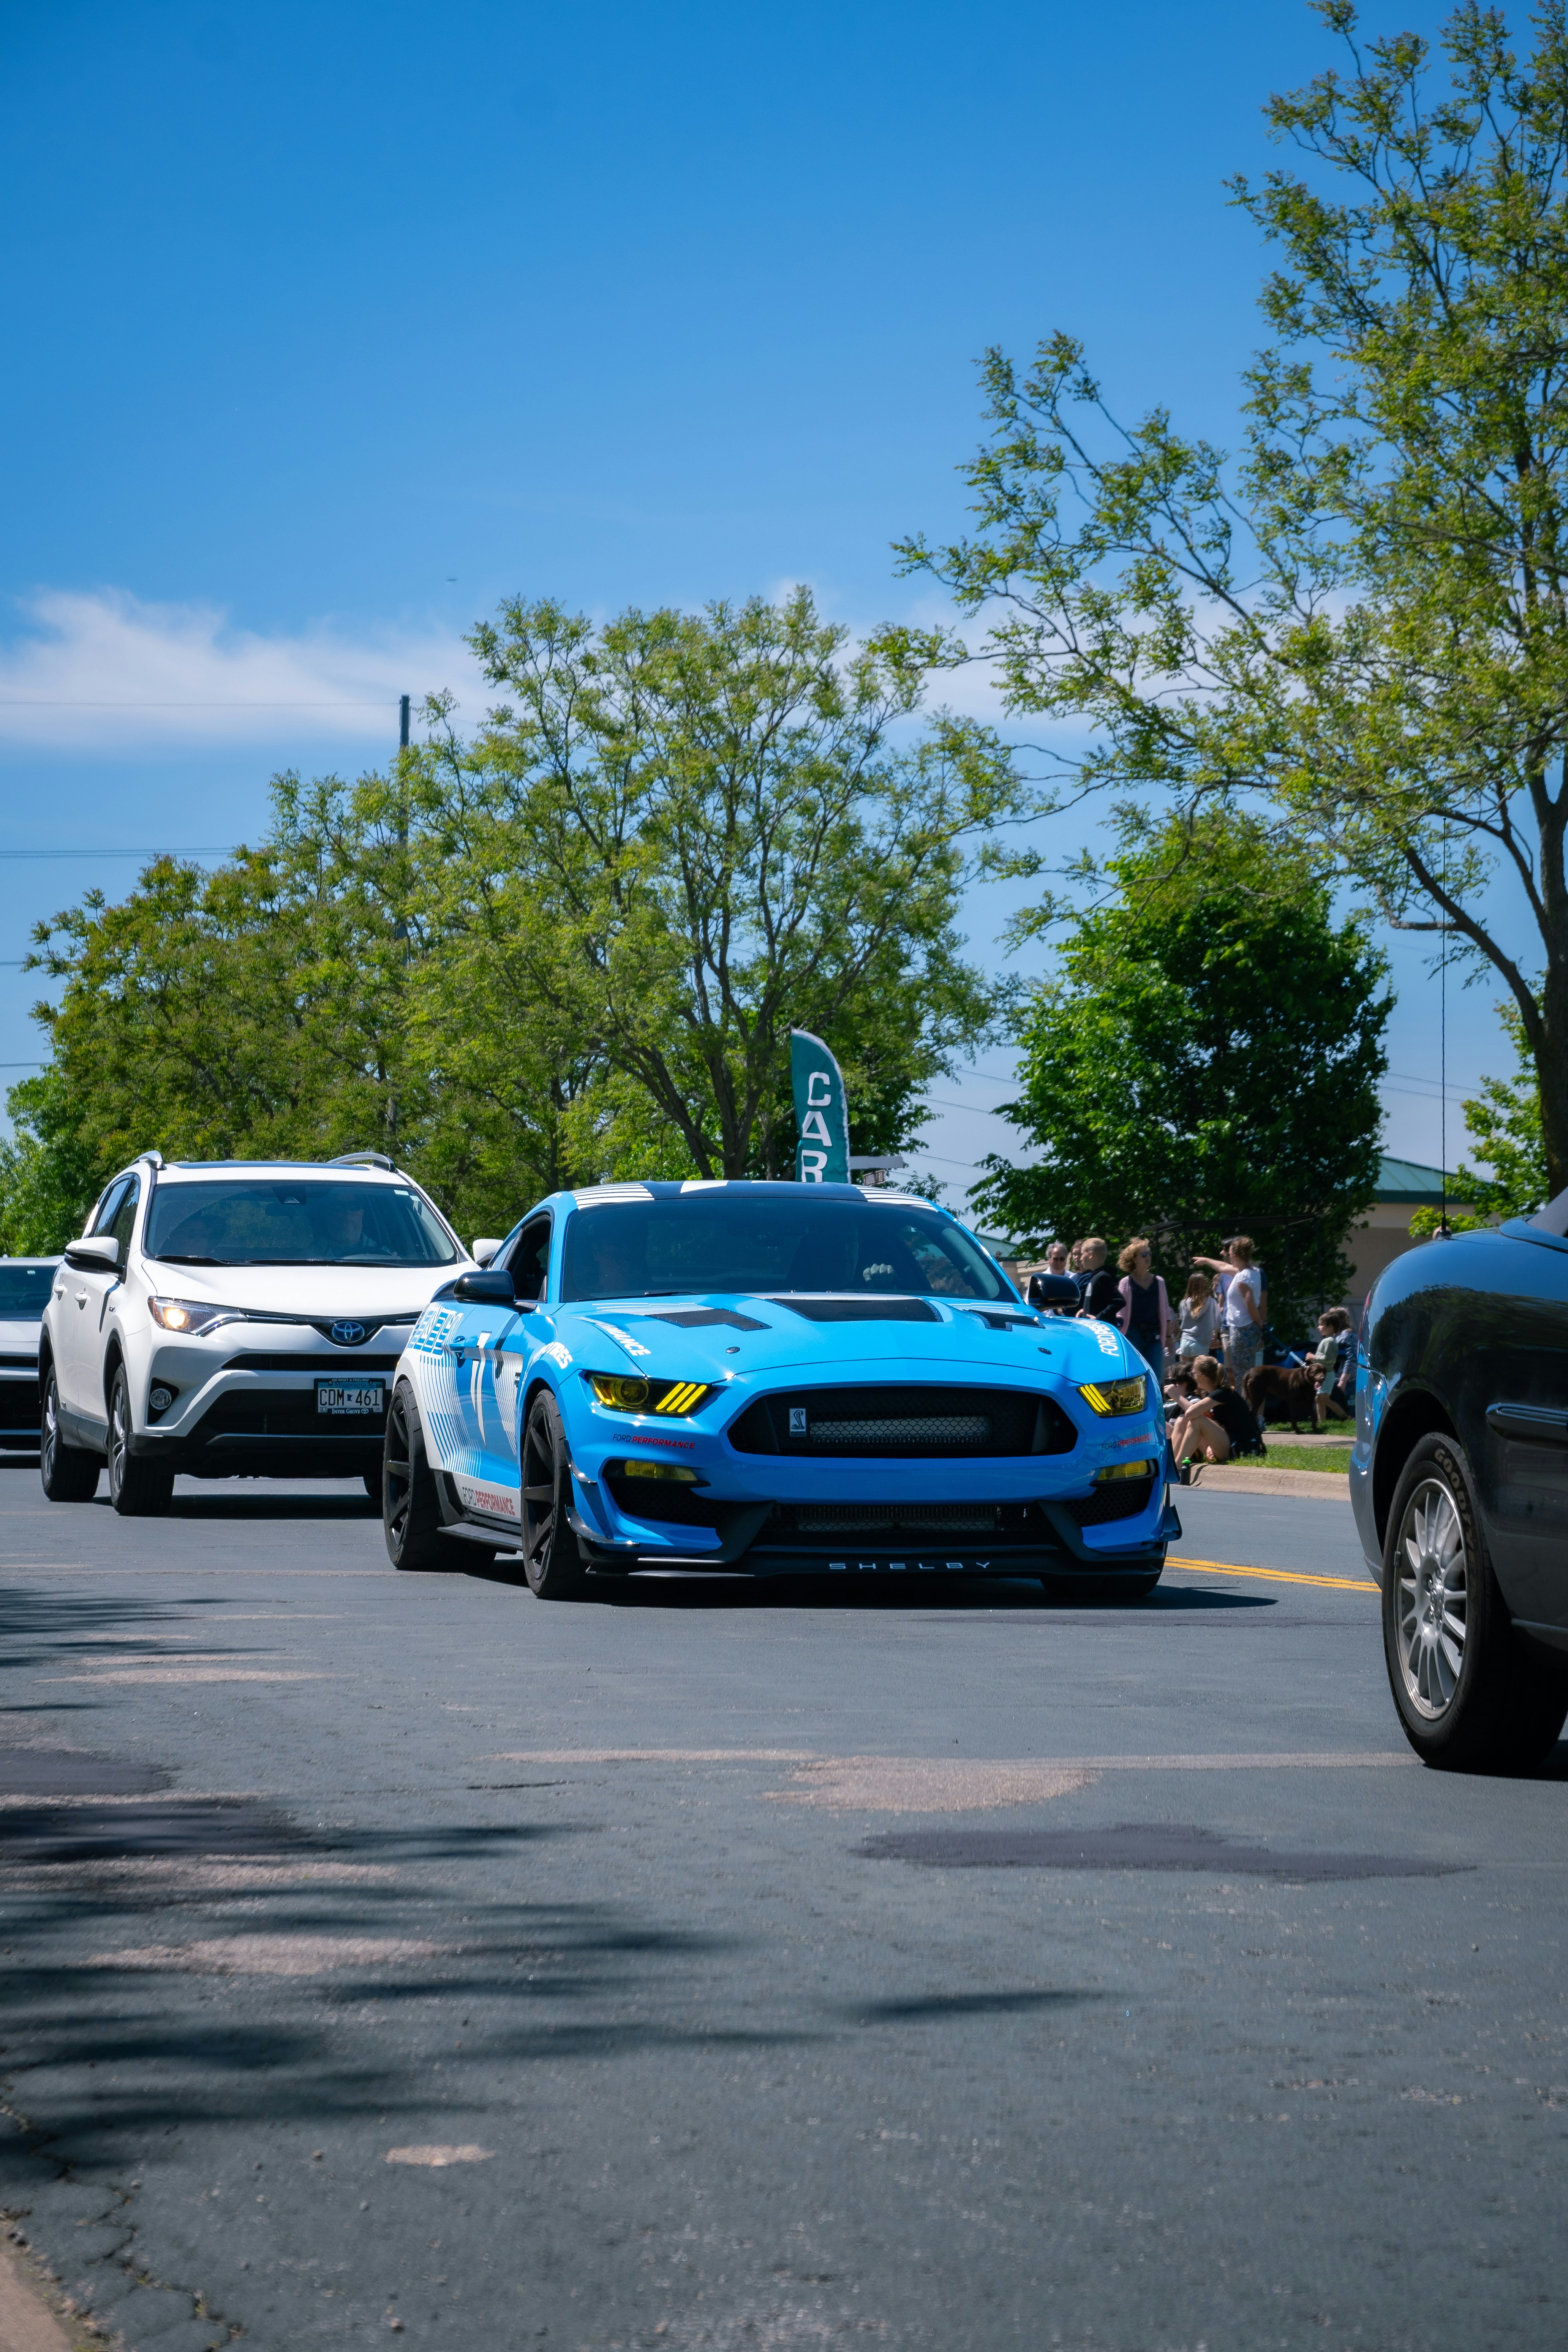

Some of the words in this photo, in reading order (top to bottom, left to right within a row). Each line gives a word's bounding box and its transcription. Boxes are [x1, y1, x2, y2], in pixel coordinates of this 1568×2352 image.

[801, 1072, 833, 1182] CAR
[320, 1389, 344, 1406] CDM
[355, 1389, 380, 1406] 461
[631, 1435, 695, 1449] PERFORMANCE
[1102, 1441, 1117, 1451] FORD
[462, 1486, 476, 1506] FORD
[475, 1490, 515, 1516] PERFORMANCE
